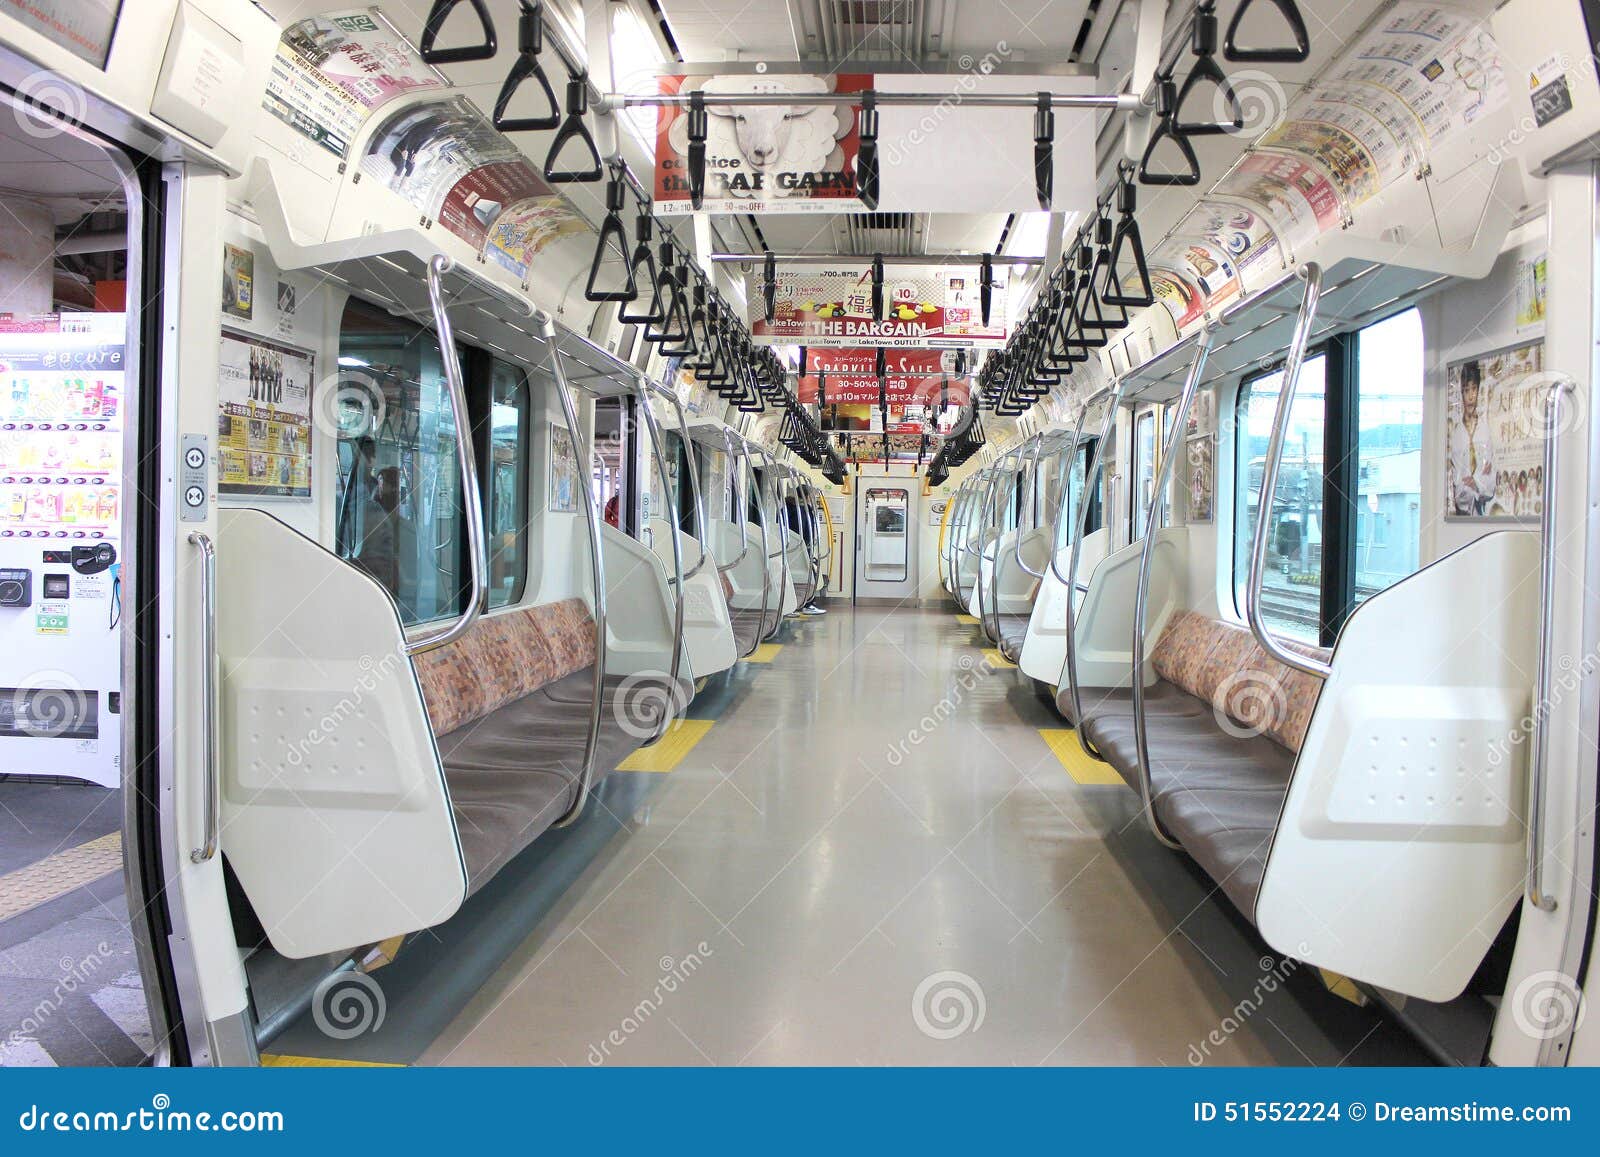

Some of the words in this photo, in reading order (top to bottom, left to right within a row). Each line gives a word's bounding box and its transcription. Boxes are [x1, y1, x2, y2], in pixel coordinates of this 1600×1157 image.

[813, 321, 843, 335] THE
[846, 321, 927, 336] BARGAIN
[899, 357, 933, 378] SALE
